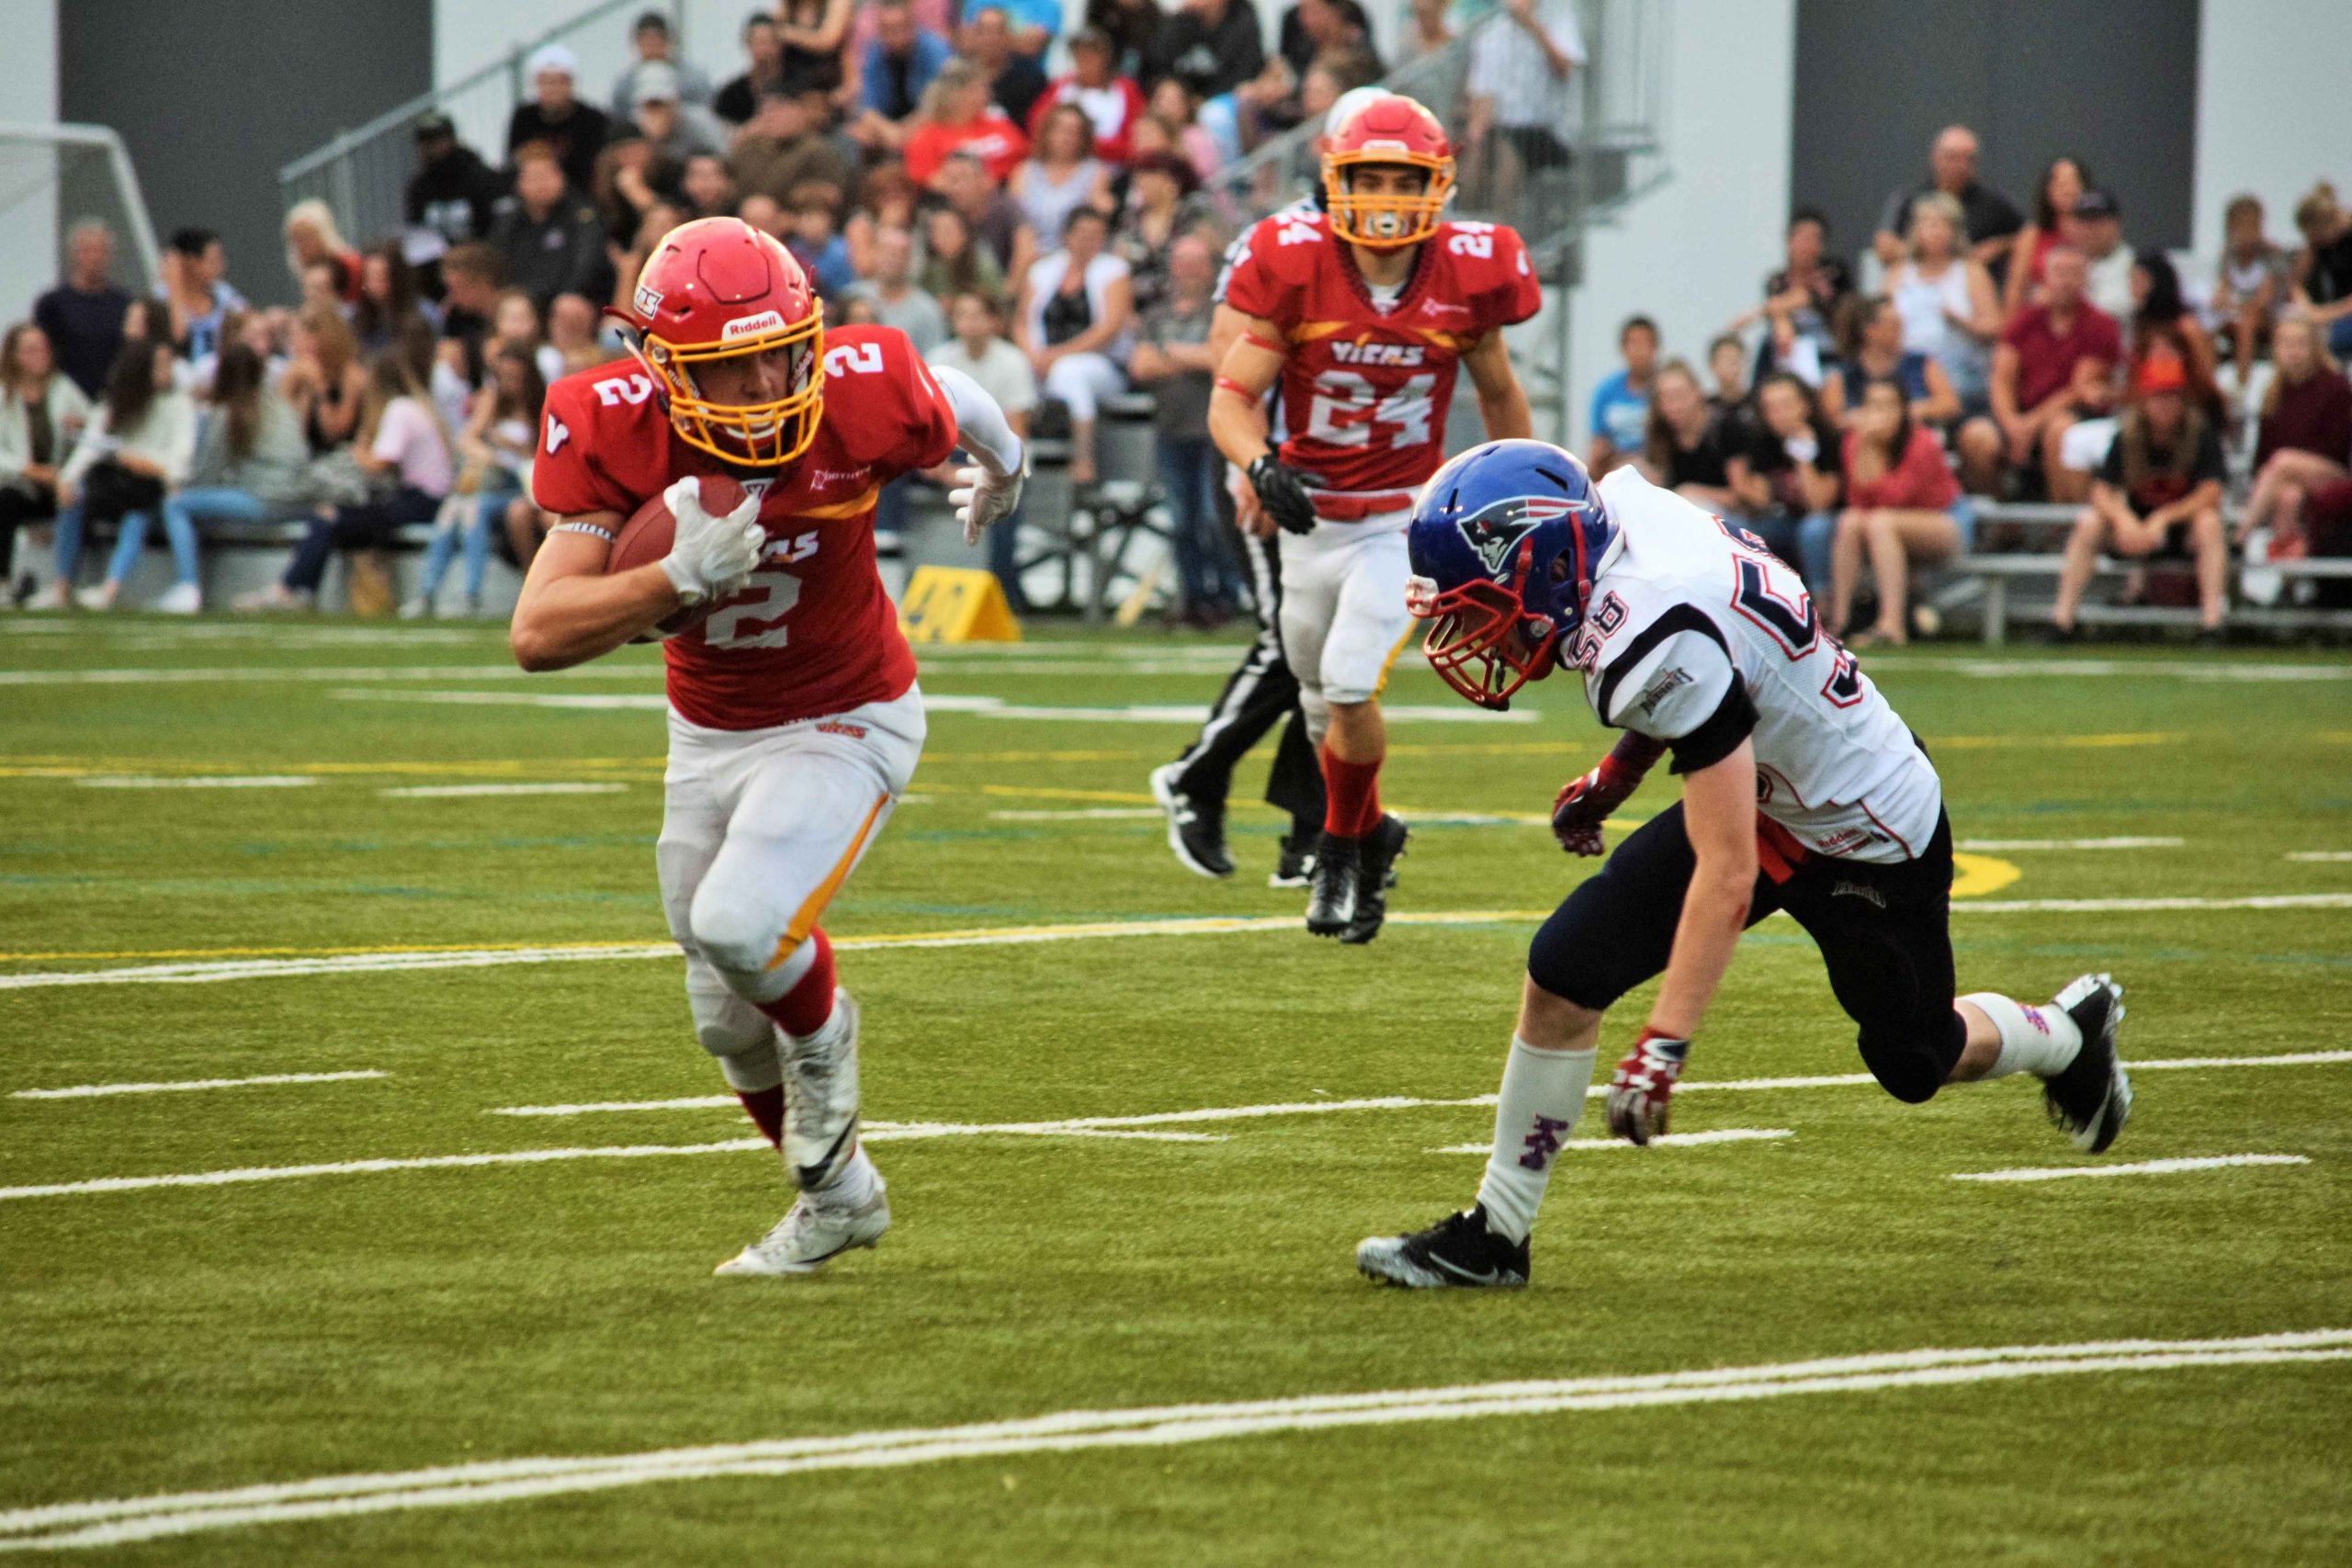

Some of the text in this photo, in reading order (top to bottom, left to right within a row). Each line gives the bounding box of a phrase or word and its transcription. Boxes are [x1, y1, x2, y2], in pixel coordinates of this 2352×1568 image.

[729, 315, 777, 335] Riddell
[823, 343, 884, 378] 2
[592, 373, 653, 406] 2
[1307, 369, 1437, 450] 24
[704, 571, 802, 650] 2
[1566, 589, 1631, 674] 58
